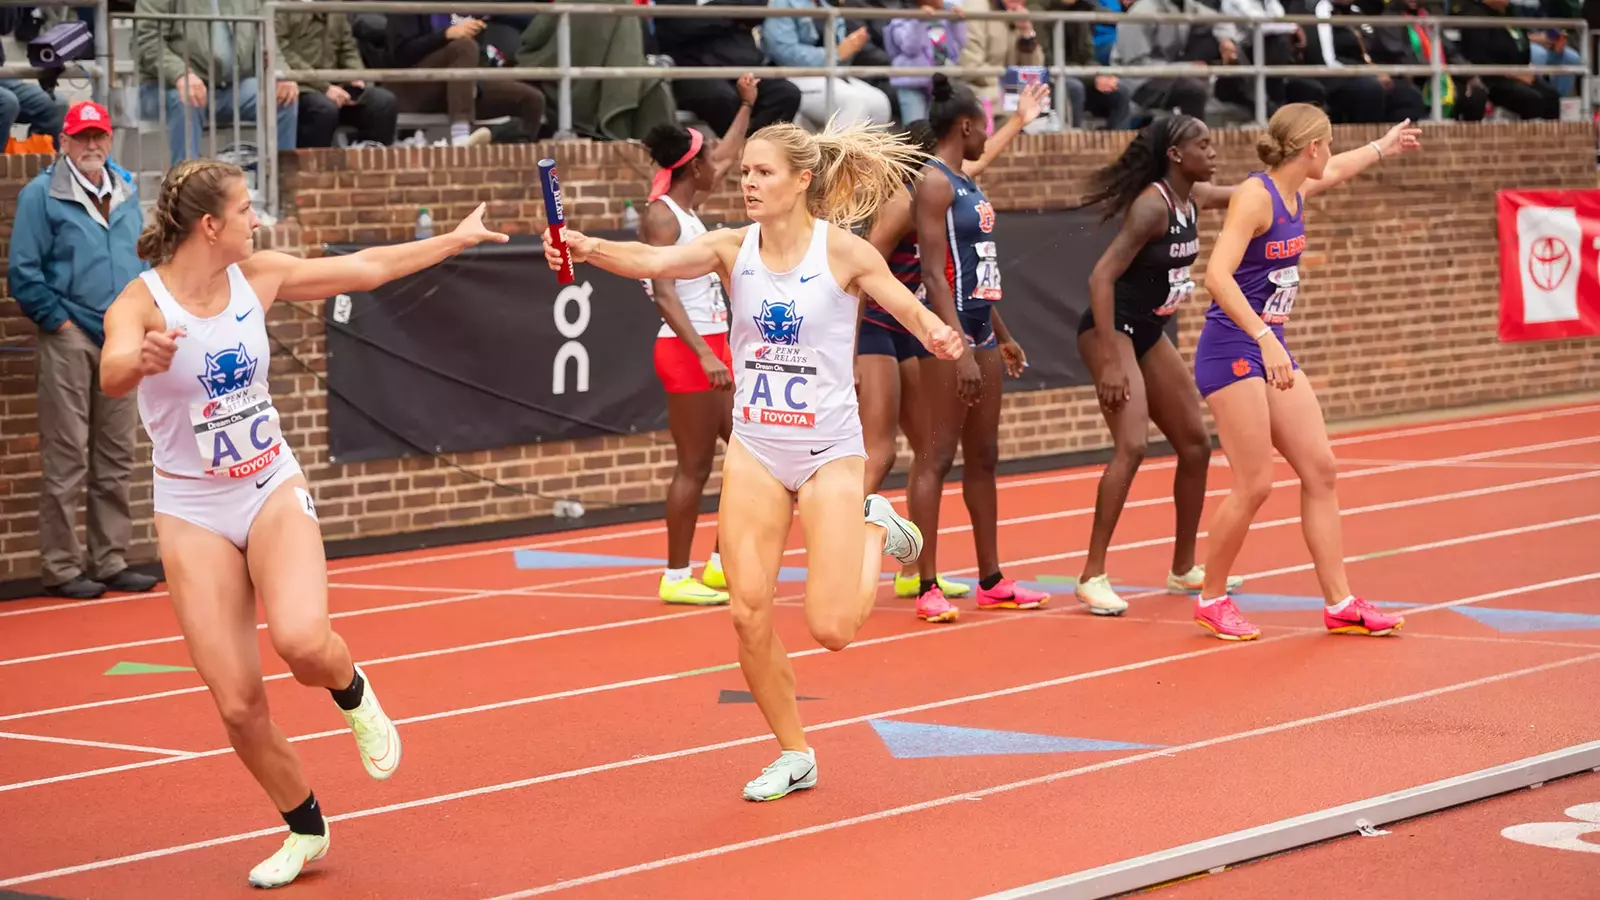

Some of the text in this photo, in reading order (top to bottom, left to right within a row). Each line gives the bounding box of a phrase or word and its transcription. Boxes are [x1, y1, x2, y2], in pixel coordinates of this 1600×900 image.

[775, 346, 801, 355] PENN
[773, 354, 808, 363] RELAYS
[755, 362, 773, 371] Dream
[225, 390, 249, 404] PENN
[749, 373, 808, 410] A C
[207, 418, 231, 430] Dream
[763, 411, 808, 425] TOYOTA
[211, 414, 273, 468] A C
[232, 451, 277, 477] TOYOTA
